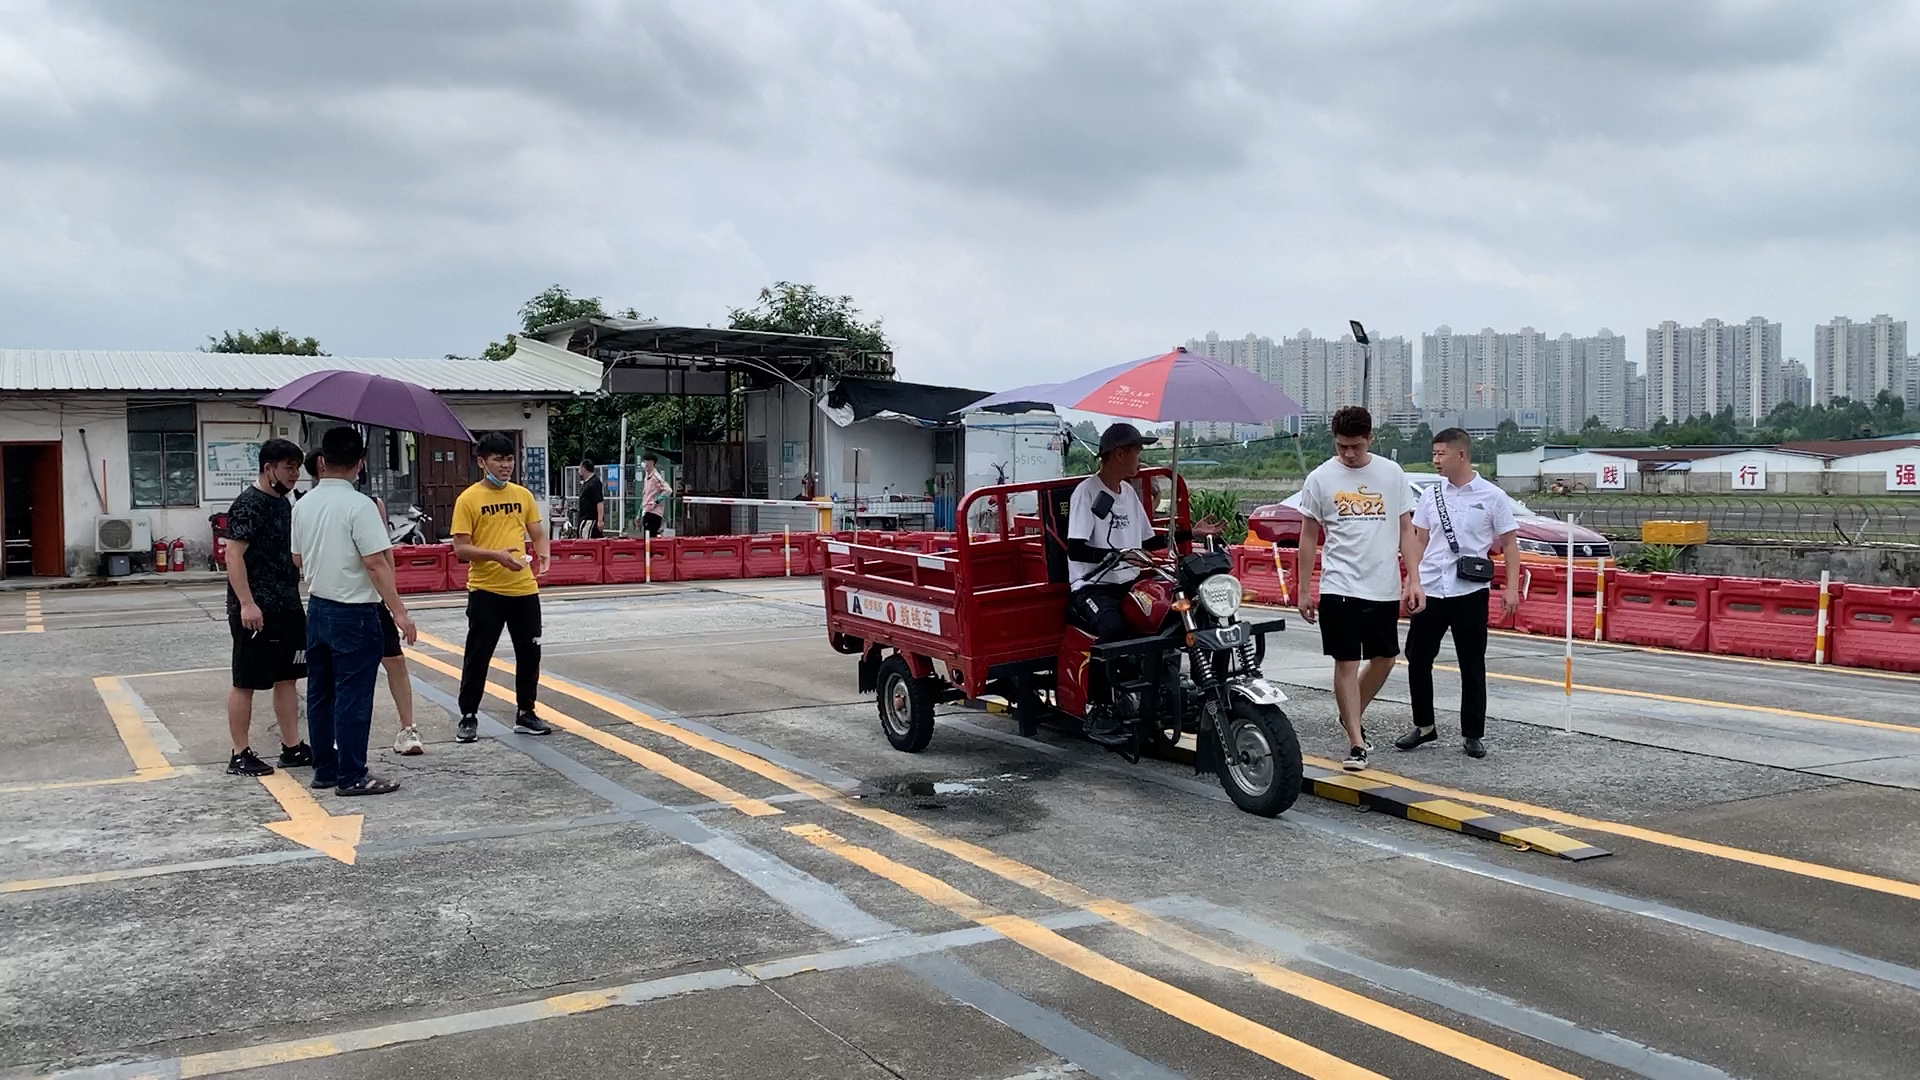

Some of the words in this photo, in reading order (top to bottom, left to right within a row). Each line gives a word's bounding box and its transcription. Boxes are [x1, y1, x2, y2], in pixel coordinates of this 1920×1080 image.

[1603, 465, 1619, 485] 践
[1740, 465, 1759, 486] 行
[1896, 464, 1916, 486] 强
[1338, 500, 1386, 516] 2022
[852, 595, 862, 615] A
[900, 604, 933, 632] 教练车
